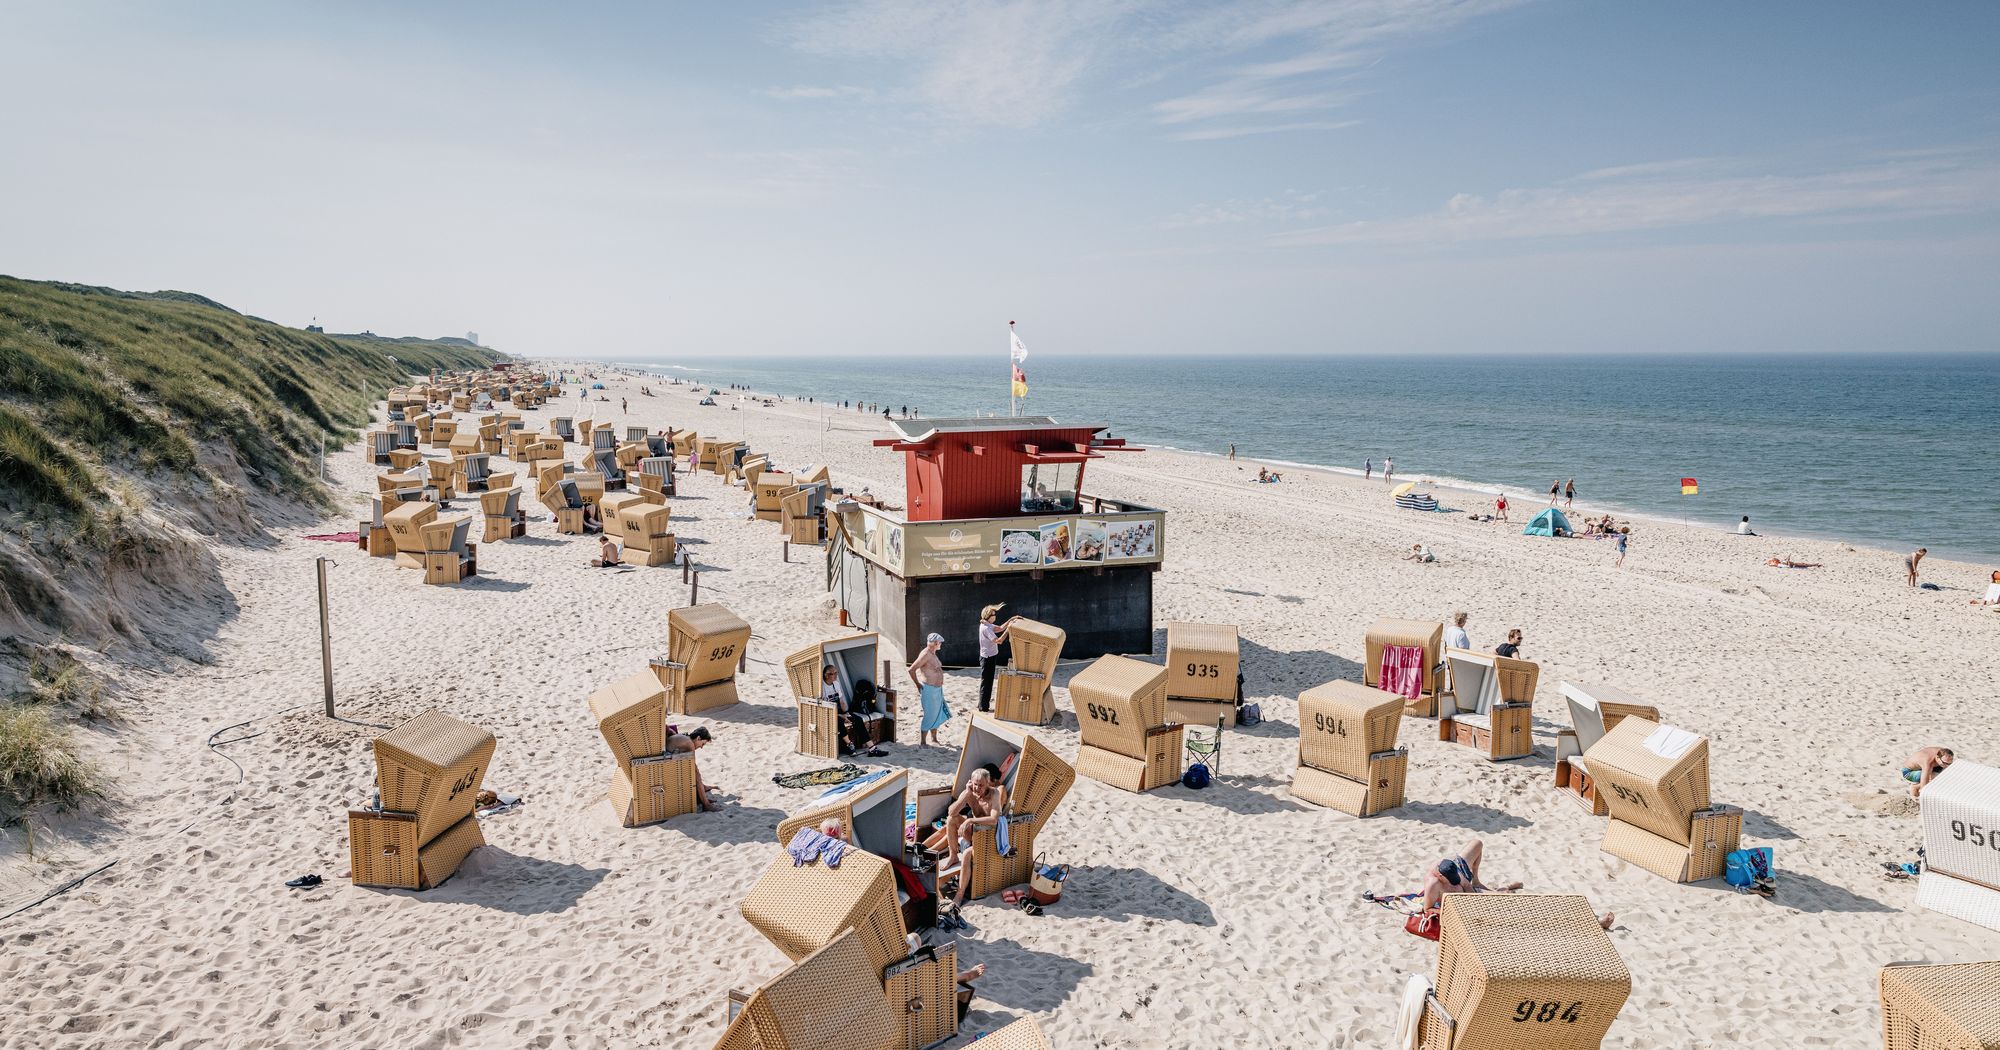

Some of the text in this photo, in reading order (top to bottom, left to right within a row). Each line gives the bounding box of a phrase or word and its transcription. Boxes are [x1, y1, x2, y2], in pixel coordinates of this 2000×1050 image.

[626, 520, 640, 532] 944
[710, 644, 735, 661] 936
[1187, 663, 1218, 678] 935
[1088, 702, 1119, 725] 992
[1316, 712, 1346, 738] 994
[449, 767, 478, 801] 949
[1612, 782, 1648, 808] 951
[887, 966, 900, 977] 982
[1512, 1000, 1583, 1023] 984
